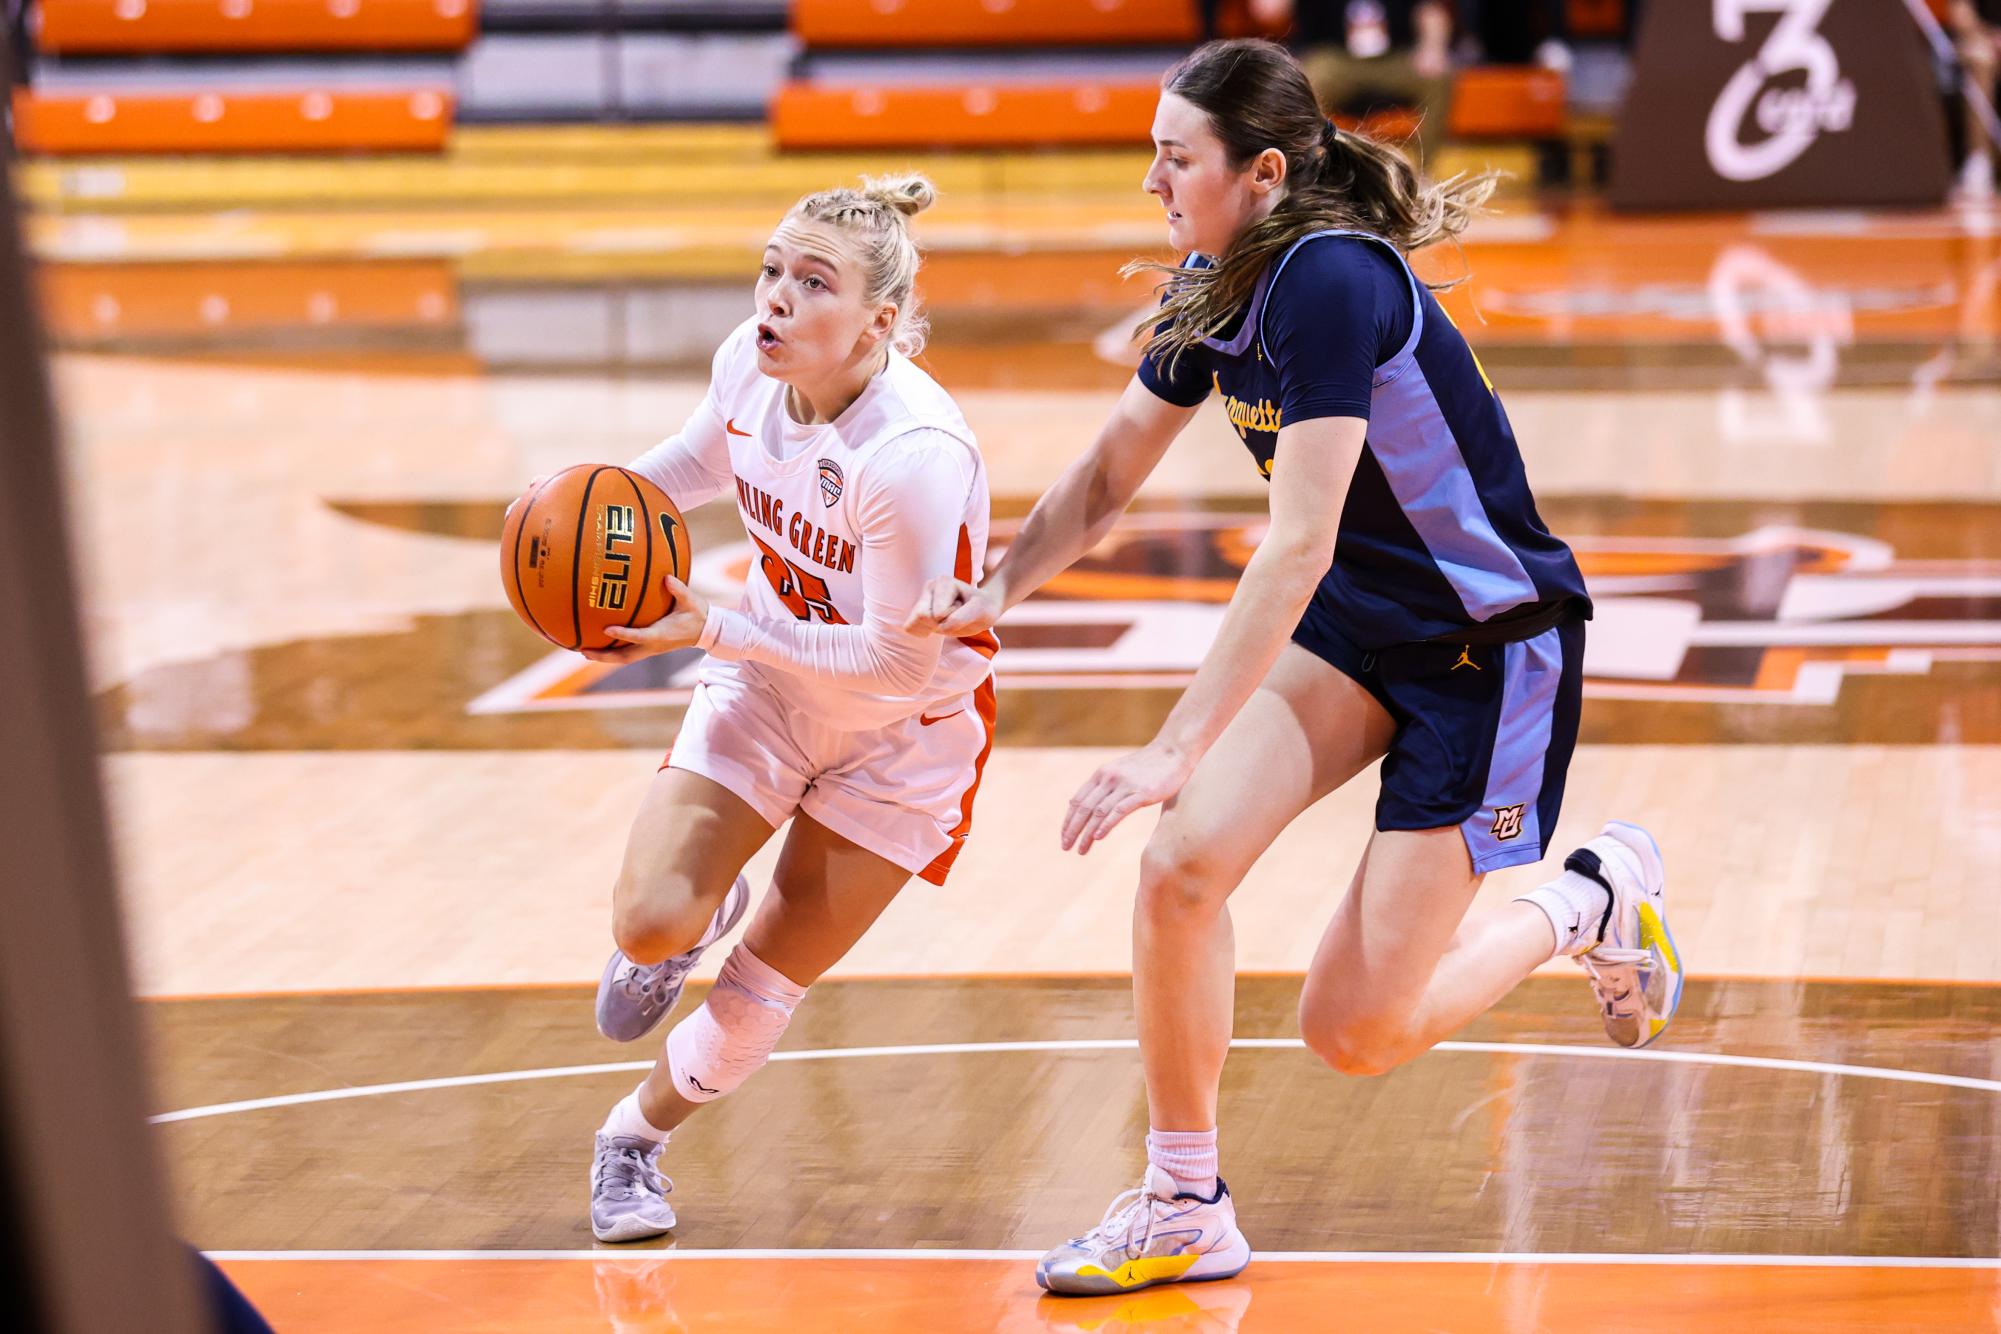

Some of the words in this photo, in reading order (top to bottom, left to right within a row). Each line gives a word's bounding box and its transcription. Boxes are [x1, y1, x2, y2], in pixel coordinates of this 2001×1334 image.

[596, 504, 634, 611] ELITE
[789, 511, 856, 575] GREEN
[1489, 802, 1526, 842] MU
